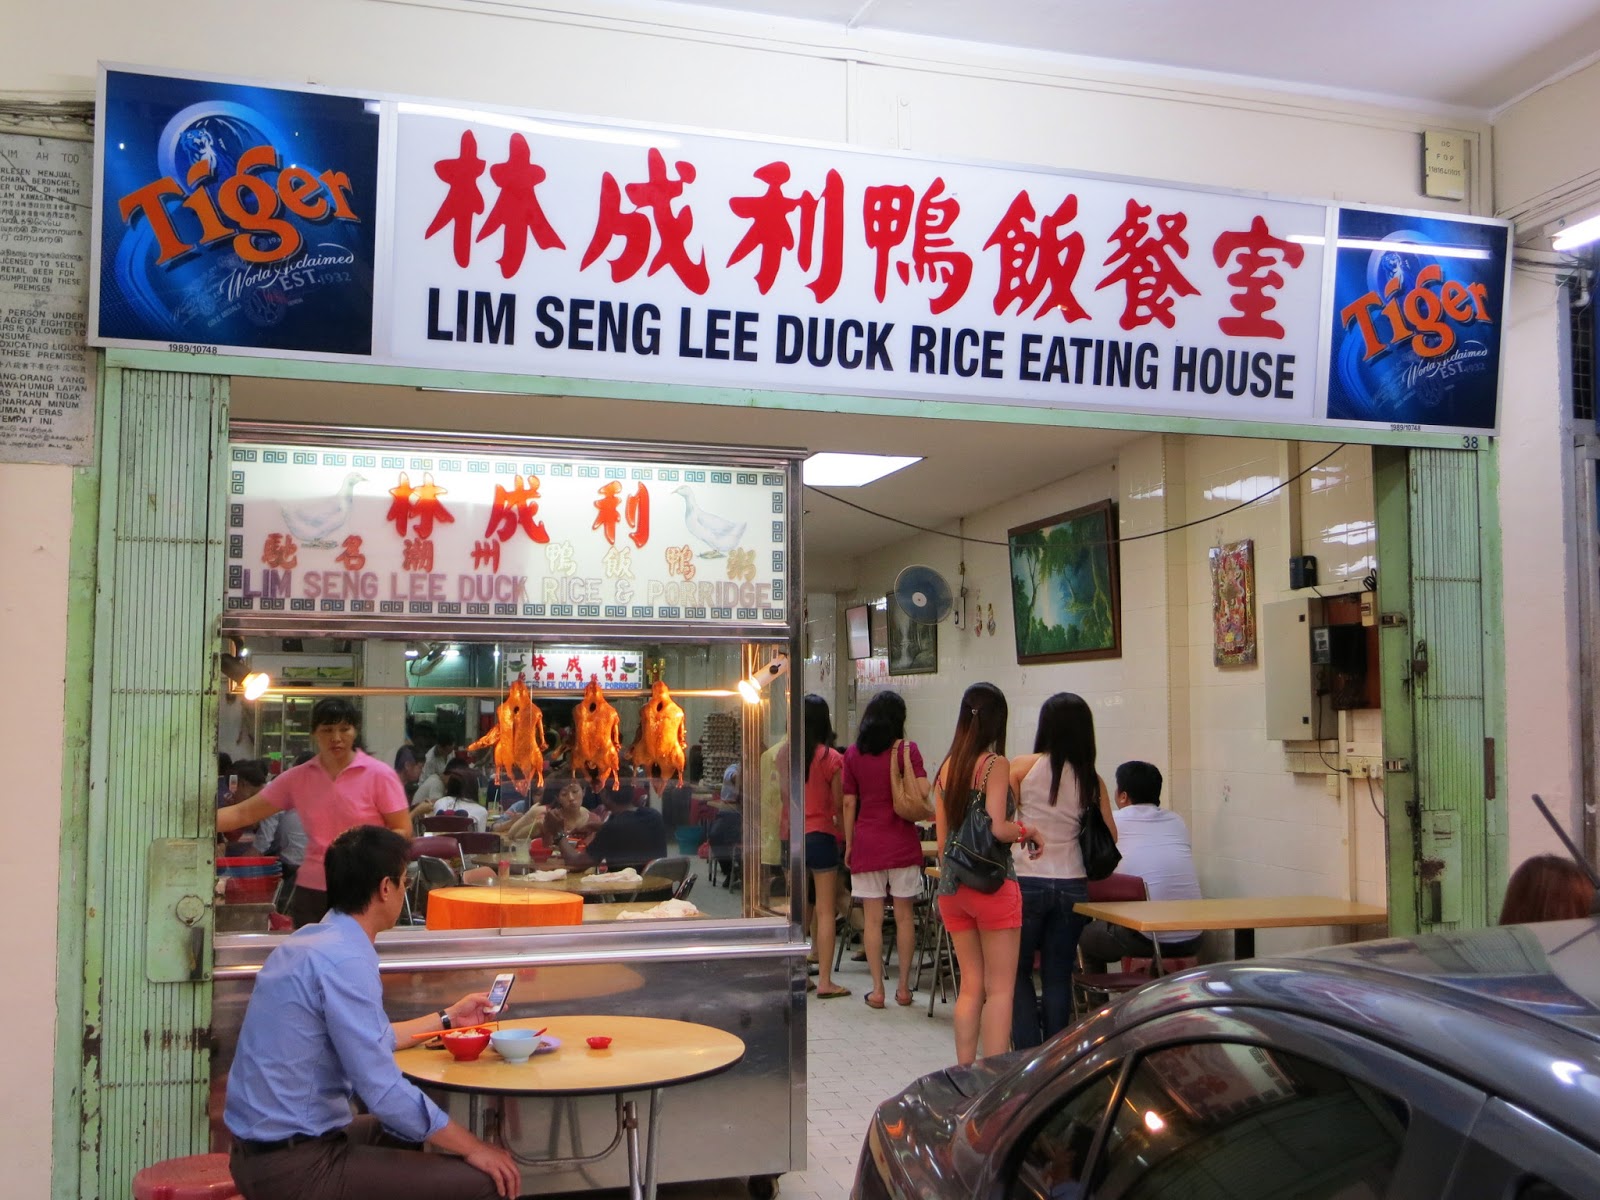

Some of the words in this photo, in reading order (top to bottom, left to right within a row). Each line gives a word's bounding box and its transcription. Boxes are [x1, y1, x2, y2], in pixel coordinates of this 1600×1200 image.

[36, 152, 49, 160] AH
[118, 145, 360, 266] Tiger
[424, 129, 1305, 339] 林成利鴨飯餐室
[40, 260, 50, 268] TO
[55, 261, 76, 269] SELL
[0, 265, 27, 274] RETAIL
[32, 268, 54, 276] BEER
[42, 276, 53, 284] ON
[57, 278, 81, 286] THESE
[278, 268, 321, 292] EST.
[8, 308, 46, 318] PERSON
[52, 312, 84, 321] UNDER
[1340, 264, 1494, 362] Tiger
[4, 316, 23, 324] AGE
[24, 318, 38, 326] OF
[40, 319, 87, 329] EIGHTEEN
[26, 327, 72, 336] ALLOWED
[427, 287, 516, 346] LIM
[534, 295, 662, 356] SENG
[679, 306, 759, 362] LEE
[775, 314, 894, 372] DUCK
[909, 324, 1005, 379] RICE
[1018, 333, 1159, 391] EATING
[1172, 345, 1296, 400] HOUSE
[1, 348, 31, 358] THESE
[168, 343, 218, 356] 1989/10748
[60, 376, 86, 385] YANG
[27, 383, 55, 391] UMUR
[57, 385, 88, 393] LAPAN
[17, 390, 49, 399] TAHUN
[55, 392, 81, 401] TIDAK
[48, 400, 80, 409] MINUM
[32, 408, 64, 417] KERAS
[1389, 424, 1421, 432] 1989/10748
[1462, 435, 1479, 449] 38
[386, 471, 650, 548] 林成利
[243, 568, 292, 599] LIM
[303, 570, 378, 600] SENG
[390, 572, 447, 601] LEE
[458, 573, 530, 603] DUCK
[541, 576, 602, 605] RICE
[614, 578, 634, 605] &
[647, 578, 772, 609] PORRIDGE
[532, 653, 617, 673] 林成利
[558, 680, 577, 689] DUCK
